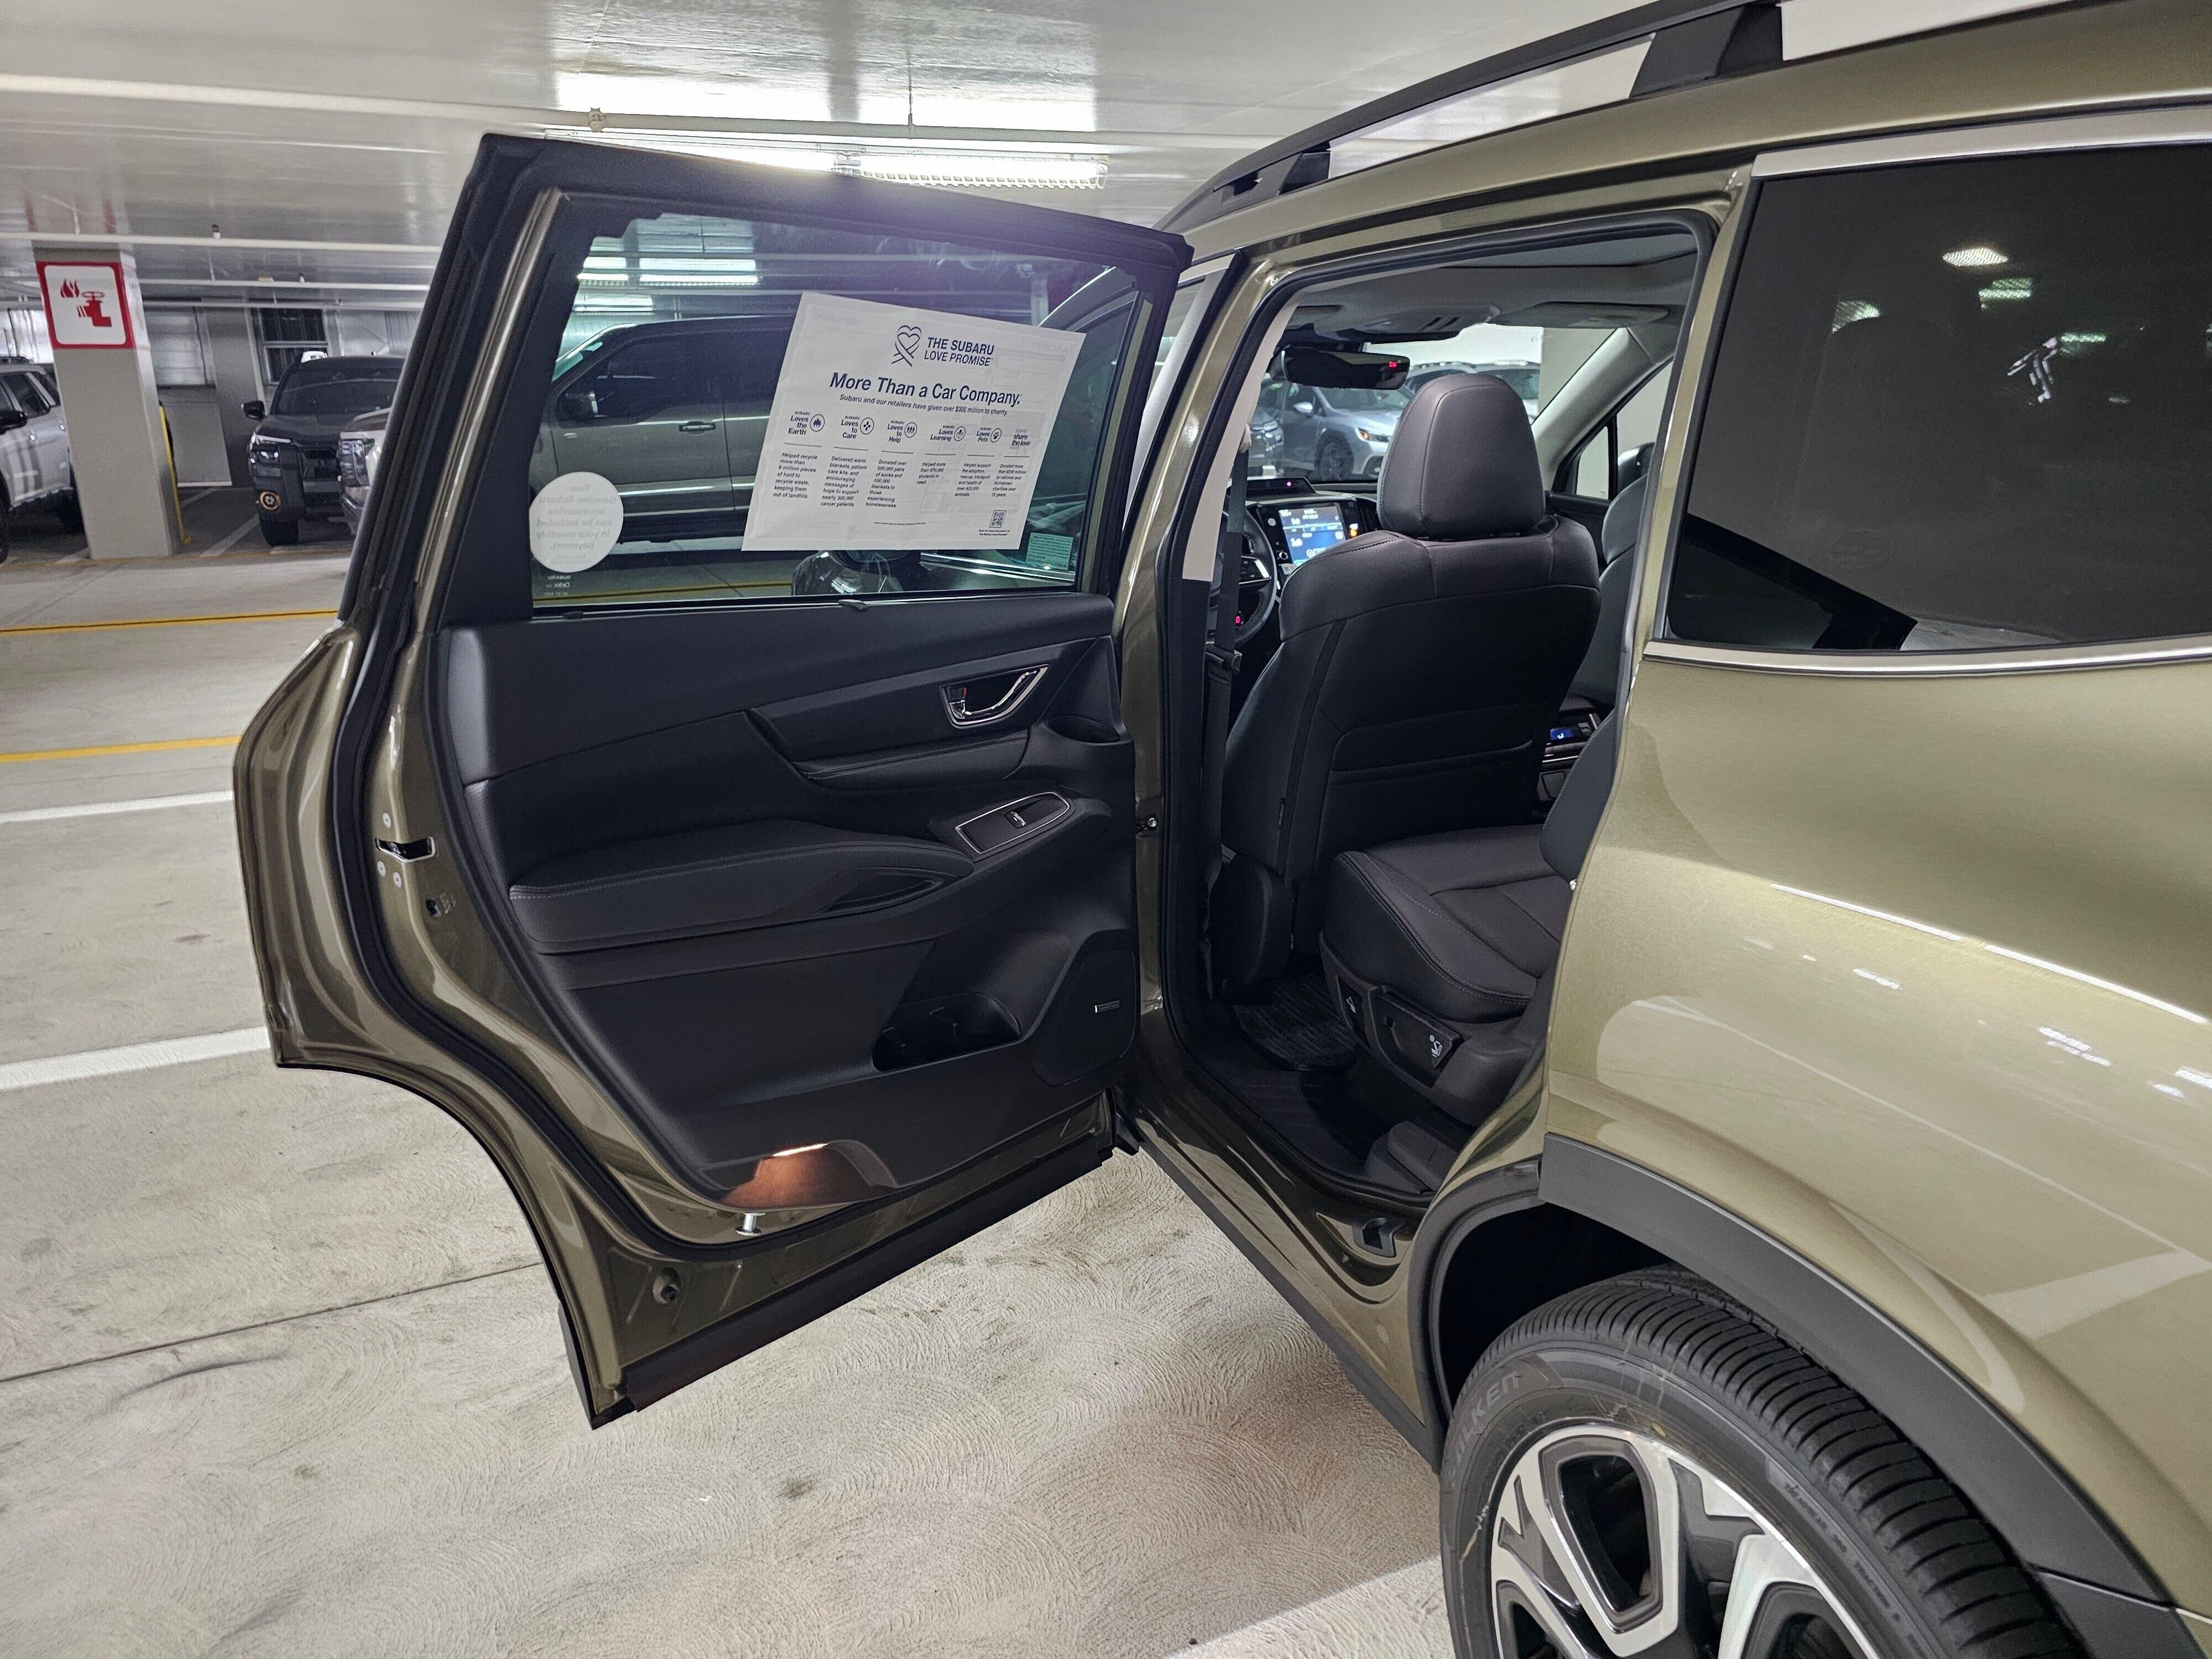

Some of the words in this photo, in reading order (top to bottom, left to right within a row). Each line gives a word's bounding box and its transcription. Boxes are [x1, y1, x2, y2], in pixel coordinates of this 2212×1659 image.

[928, 337, 949, 349] THE
[951, 340, 994, 355] SUBARU
[924, 350, 948, 361] LOVE
[830, 372, 871, 390] More
[878, 377, 915, 396] Than
[919, 387, 927, 397] a
[932, 383, 956, 399] Car
